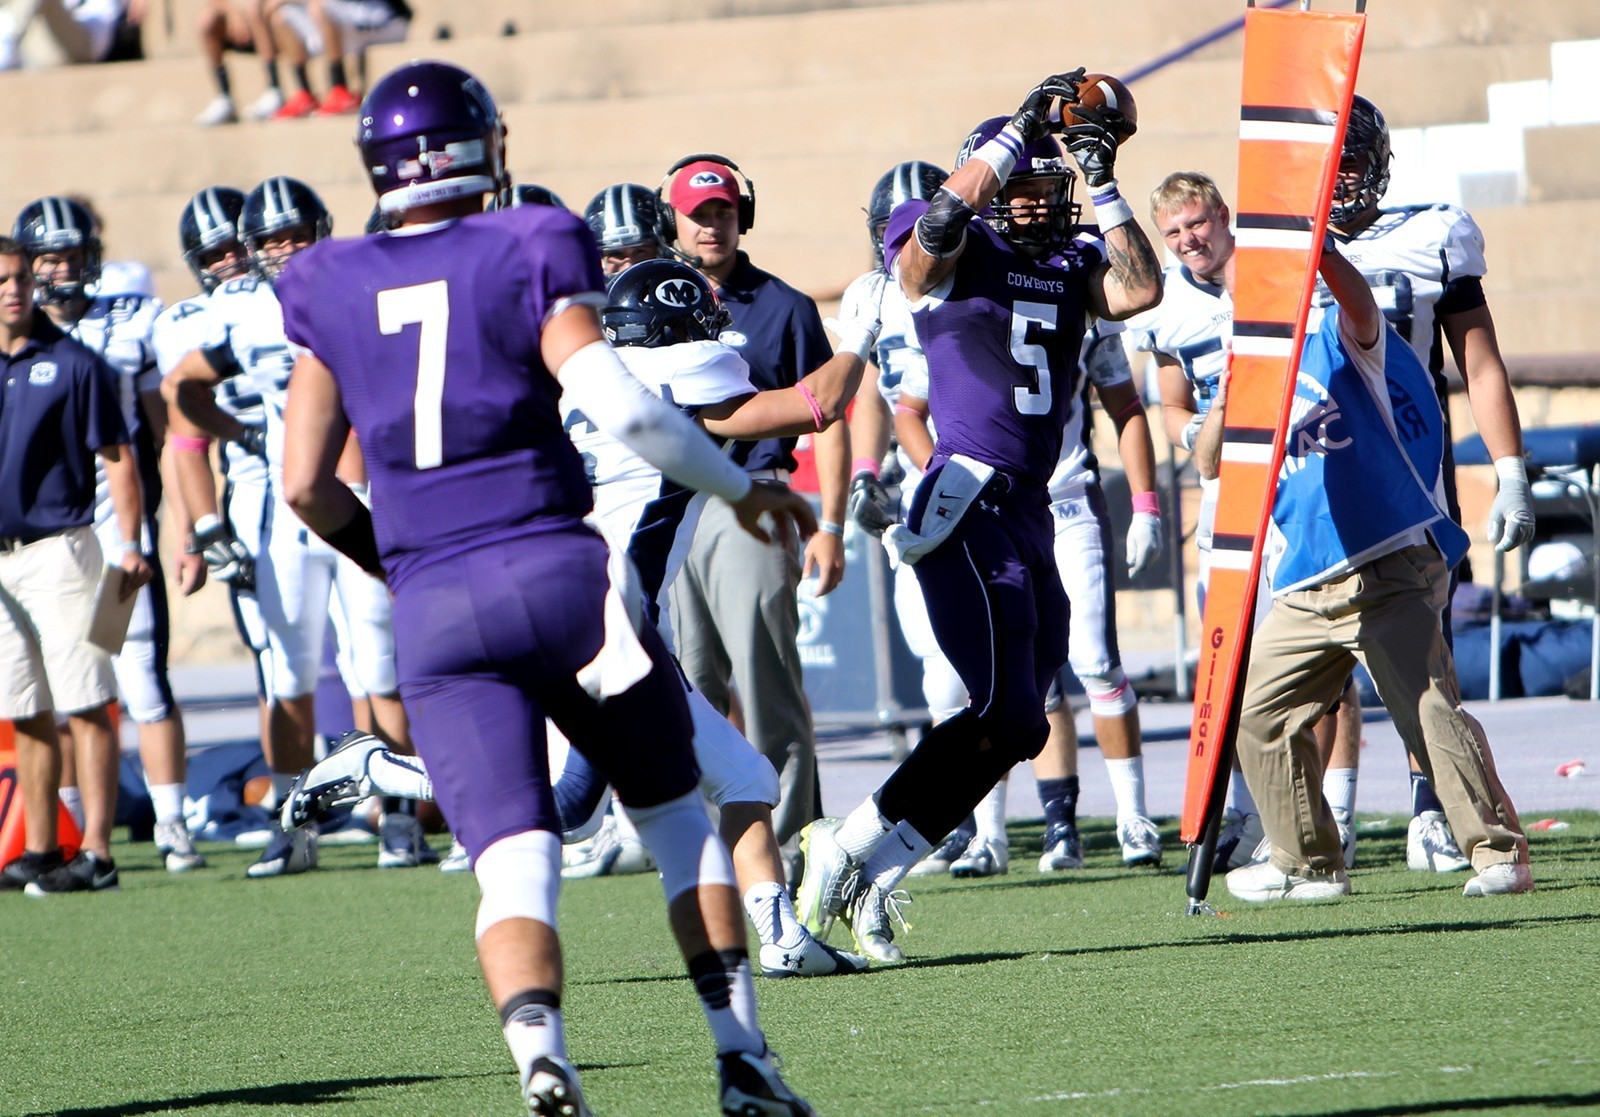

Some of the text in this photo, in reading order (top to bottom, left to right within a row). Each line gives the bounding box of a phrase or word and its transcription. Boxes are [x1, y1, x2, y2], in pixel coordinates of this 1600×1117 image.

[660, 280, 700, 307] M
[1006, 271, 1064, 293] COWBOYS
[1211, 310, 1234, 326] MINE
[1009, 299, 1058, 416] 5
[377, 279, 449, 470] 7
[1057, 502, 1078, 518] M
[1195, 626, 1224, 757] Gilman
